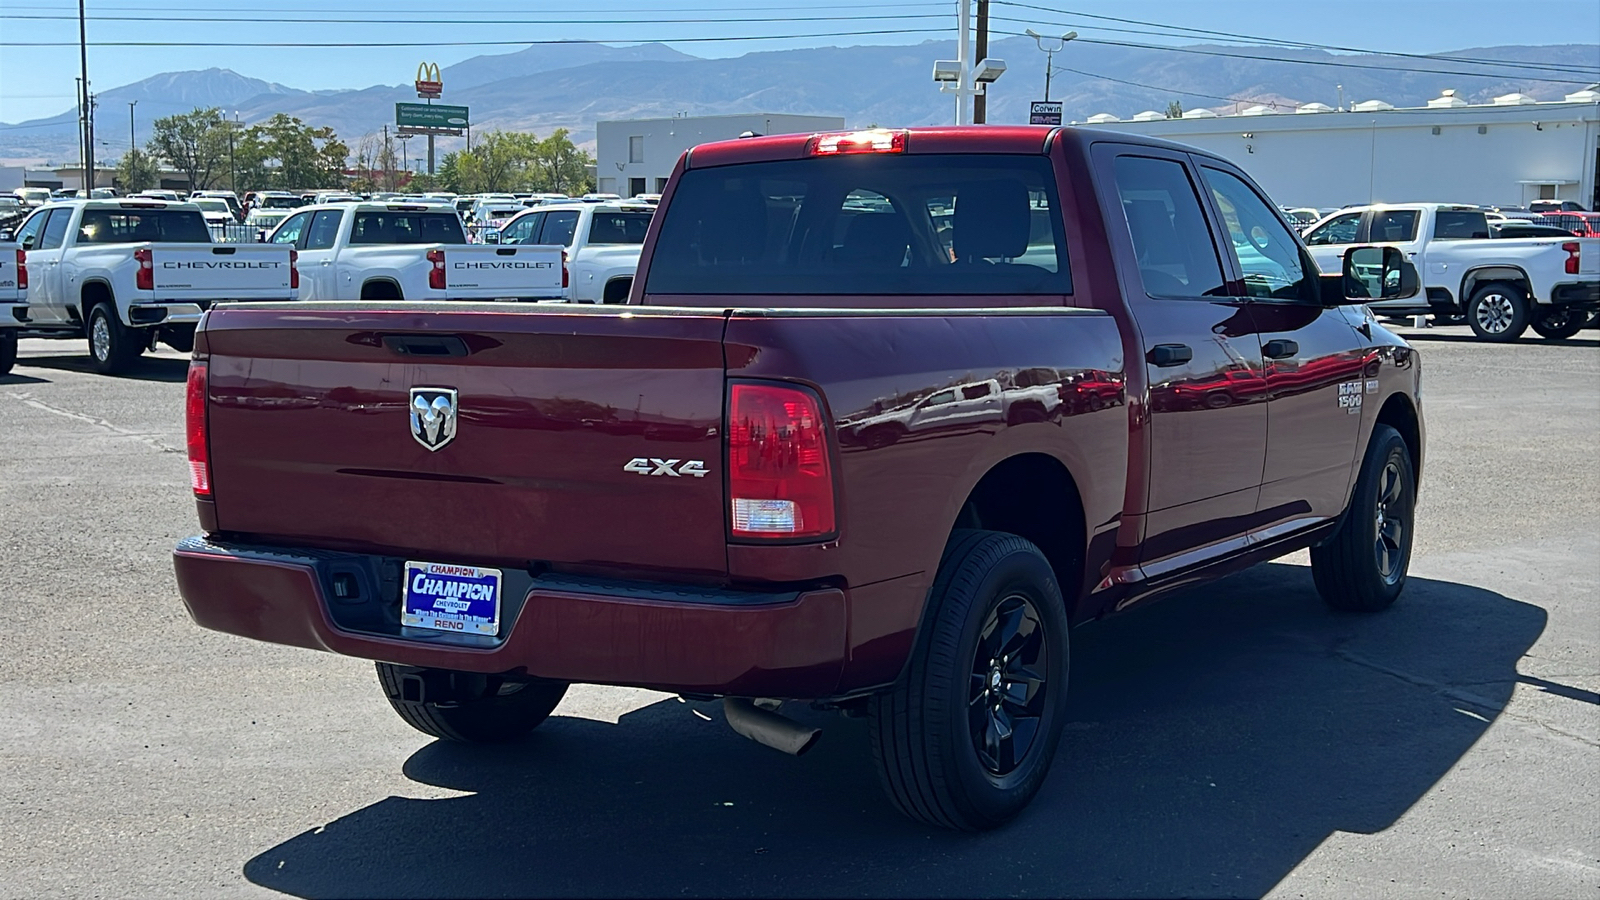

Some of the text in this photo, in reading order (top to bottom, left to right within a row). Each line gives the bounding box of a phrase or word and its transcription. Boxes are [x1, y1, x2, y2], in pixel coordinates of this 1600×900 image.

[1031, 116, 1060, 124] GMC
[1338, 395, 1362, 408] 1500
[430, 565, 475, 577] CHAMPION
[435, 600, 468, 610] CHEVROLET
[434, 620, 464, 630] RENO
